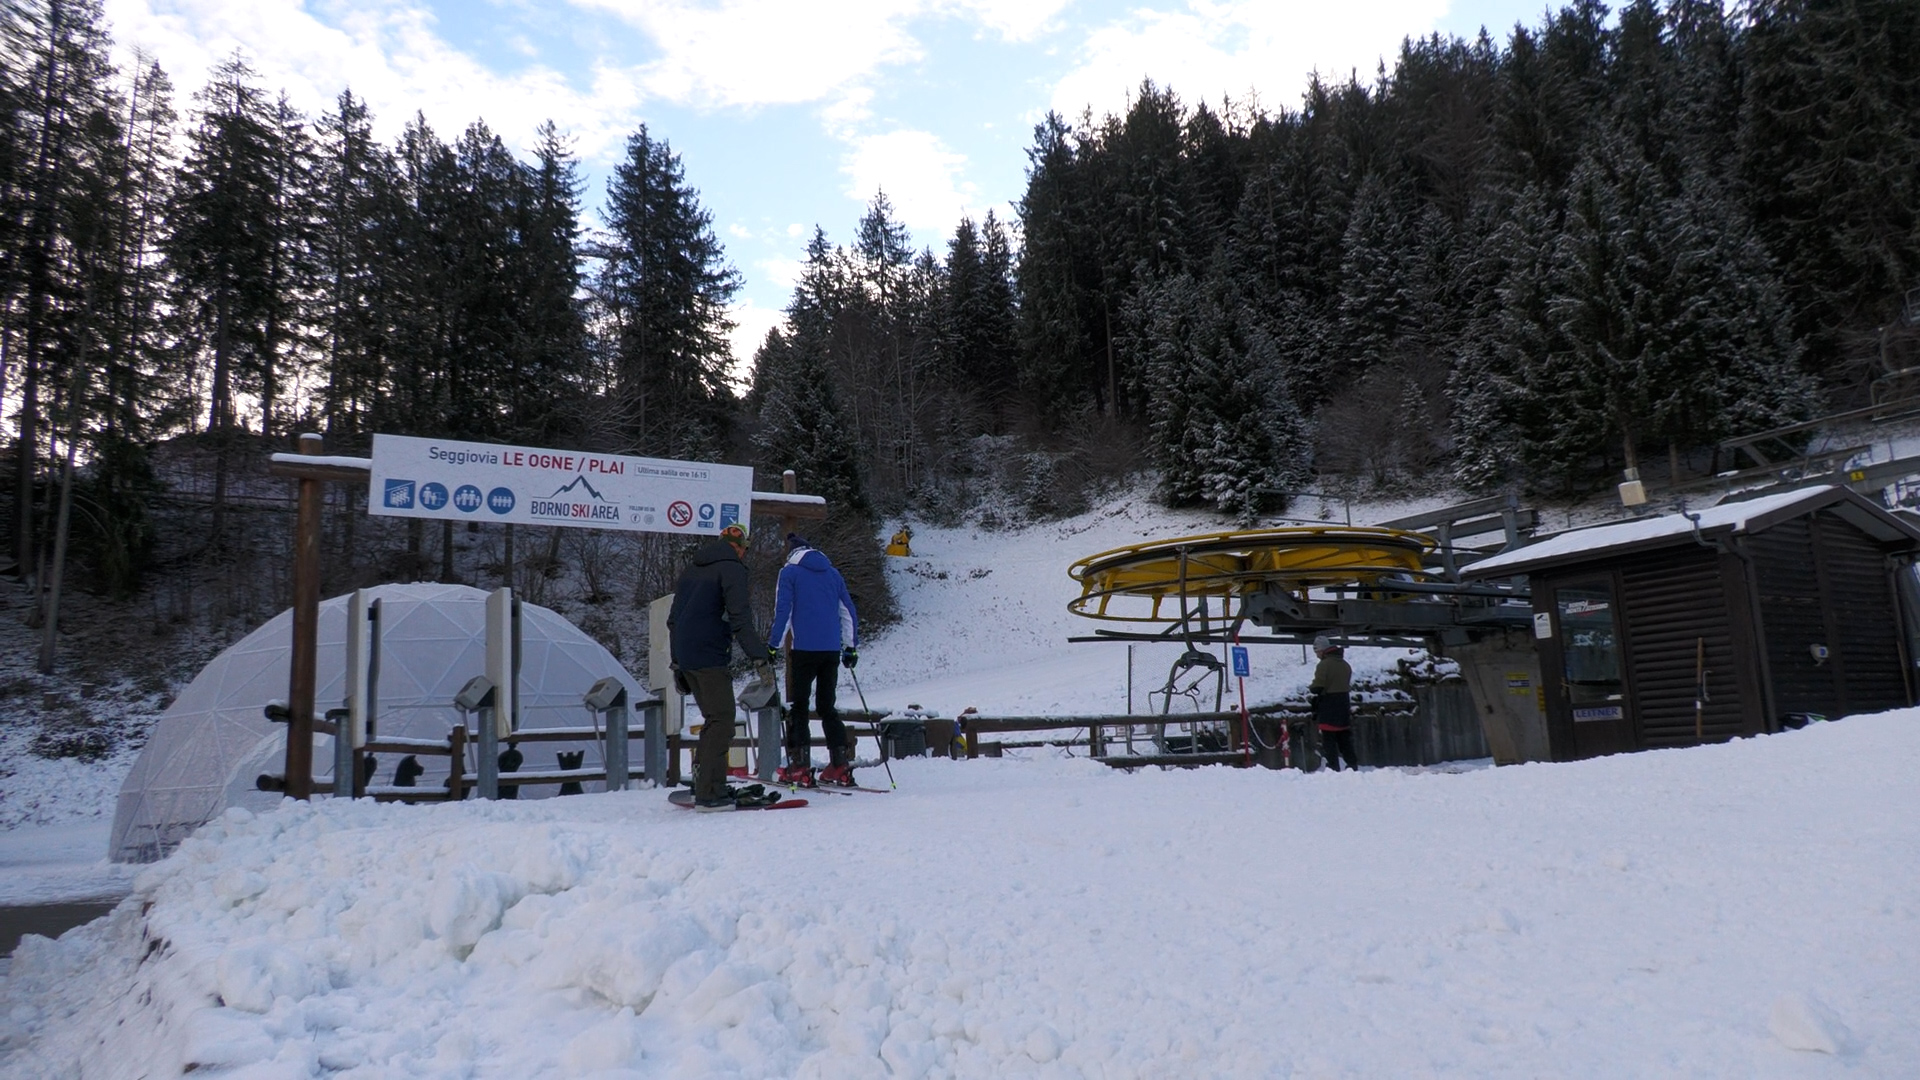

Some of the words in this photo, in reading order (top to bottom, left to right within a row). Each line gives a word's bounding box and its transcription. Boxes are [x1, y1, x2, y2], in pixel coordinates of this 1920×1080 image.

[429, 446, 498, 465] Seggiovia
[503, 452, 524, 466] LE
[528, 454, 574, 470] OGNE
[589, 459, 624, 474] PLAI
[638, 466, 659, 475] Ultima
[531, 501, 570, 517] BORNO
[571, 503, 590, 518] SKI
[591, 505, 620, 520] AREA
[1576, 707, 1618, 718] LEITNER
